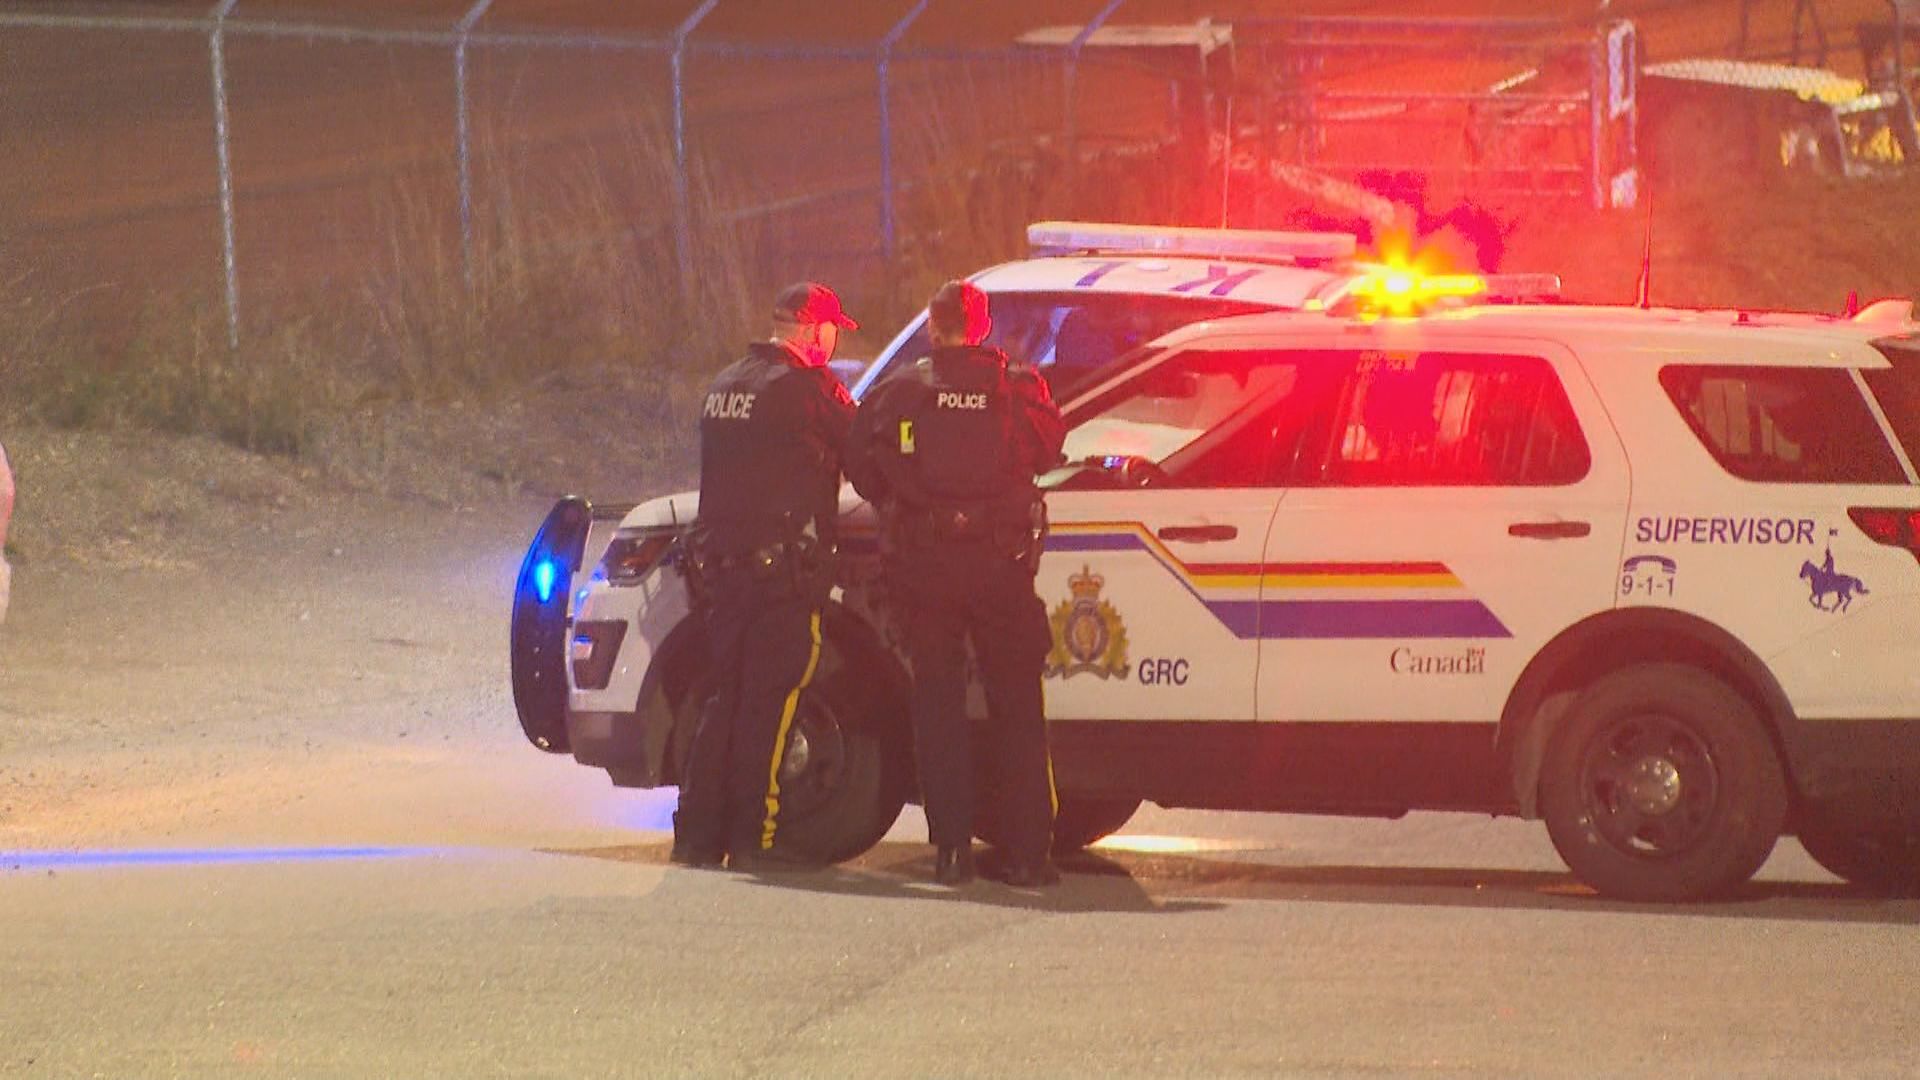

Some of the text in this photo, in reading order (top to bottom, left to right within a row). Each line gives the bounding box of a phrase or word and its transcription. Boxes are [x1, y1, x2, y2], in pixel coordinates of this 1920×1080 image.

[704, 392, 756, 420] POLICE
[938, 392, 987, 410] POLICE
[1636, 516, 1815, 545] SUPERVISOR
[1621, 575, 1676, 597] 9-1-1
[1138, 657, 1189, 686] GRC
[1390, 647, 1485, 676] Canada
